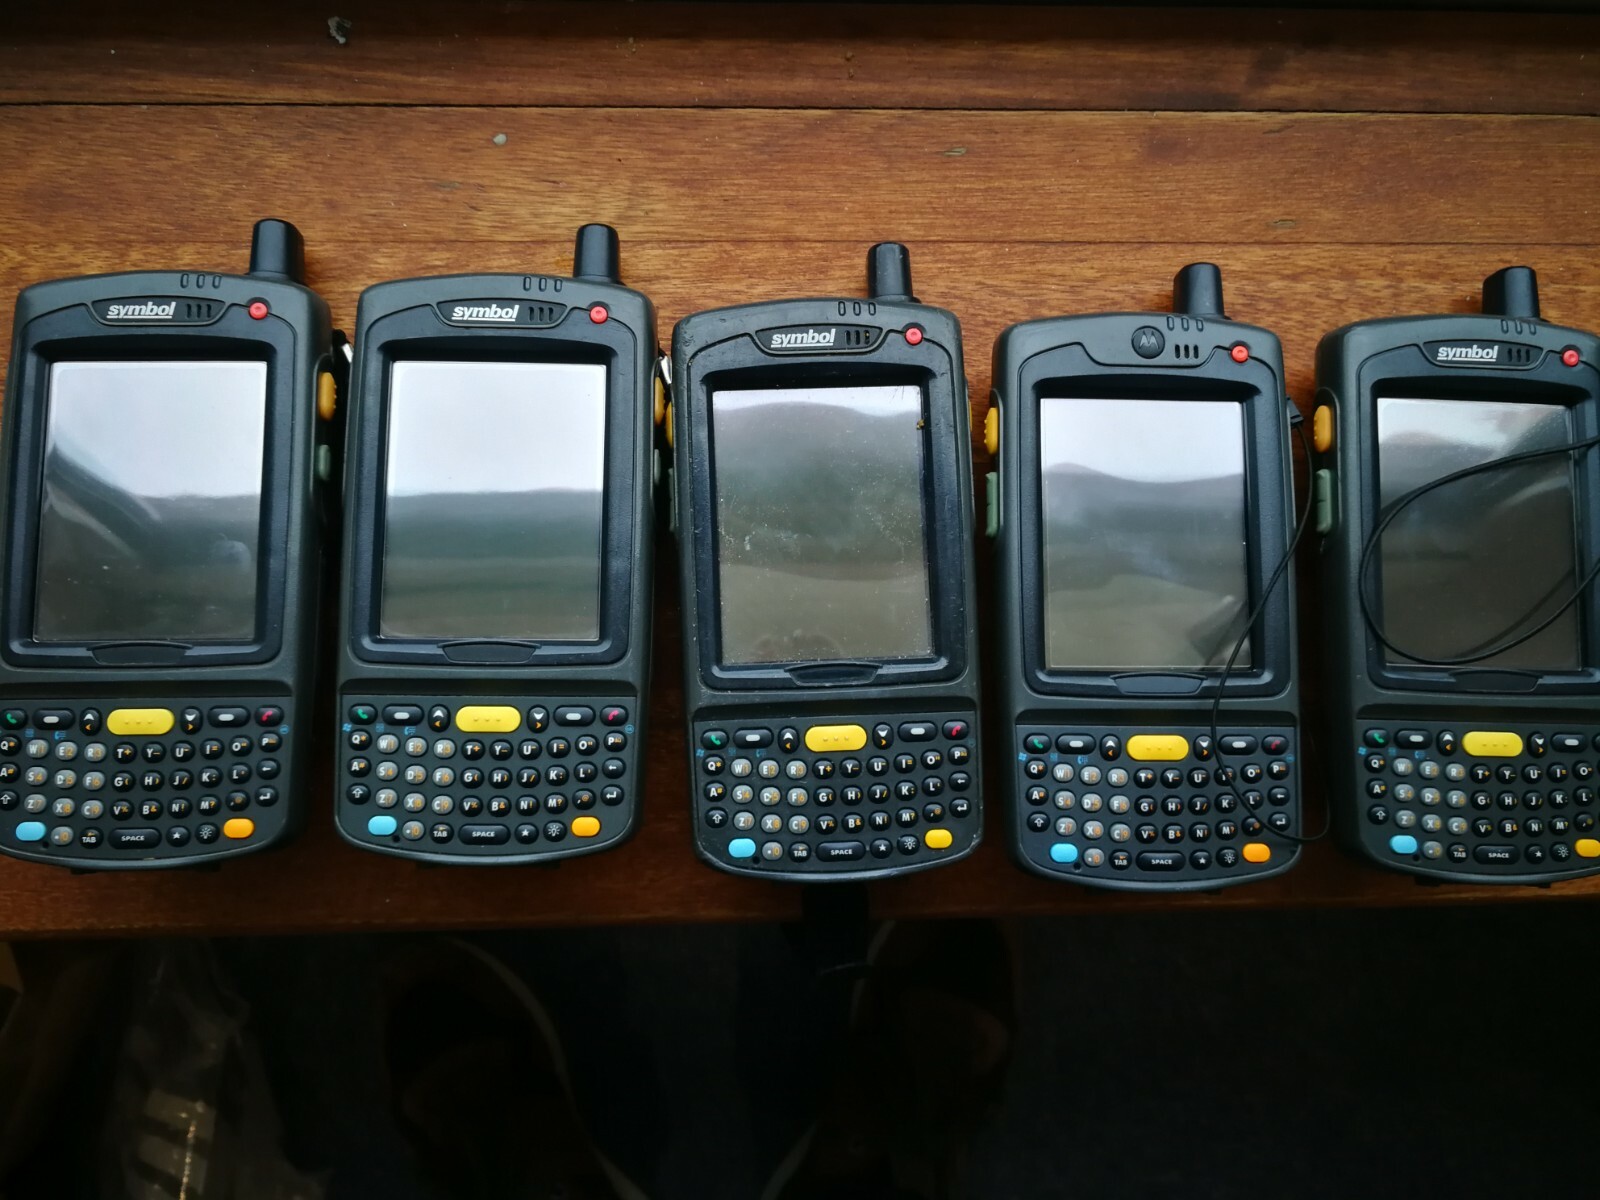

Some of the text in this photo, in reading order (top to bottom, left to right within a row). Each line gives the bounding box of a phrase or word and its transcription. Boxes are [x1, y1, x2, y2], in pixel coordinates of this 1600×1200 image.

[106, 302, 176, 319] symbol
[451, 304, 520, 322] symbol
[771, 329, 836, 348] symbol
[1437, 345, 1499, 362] symbol
